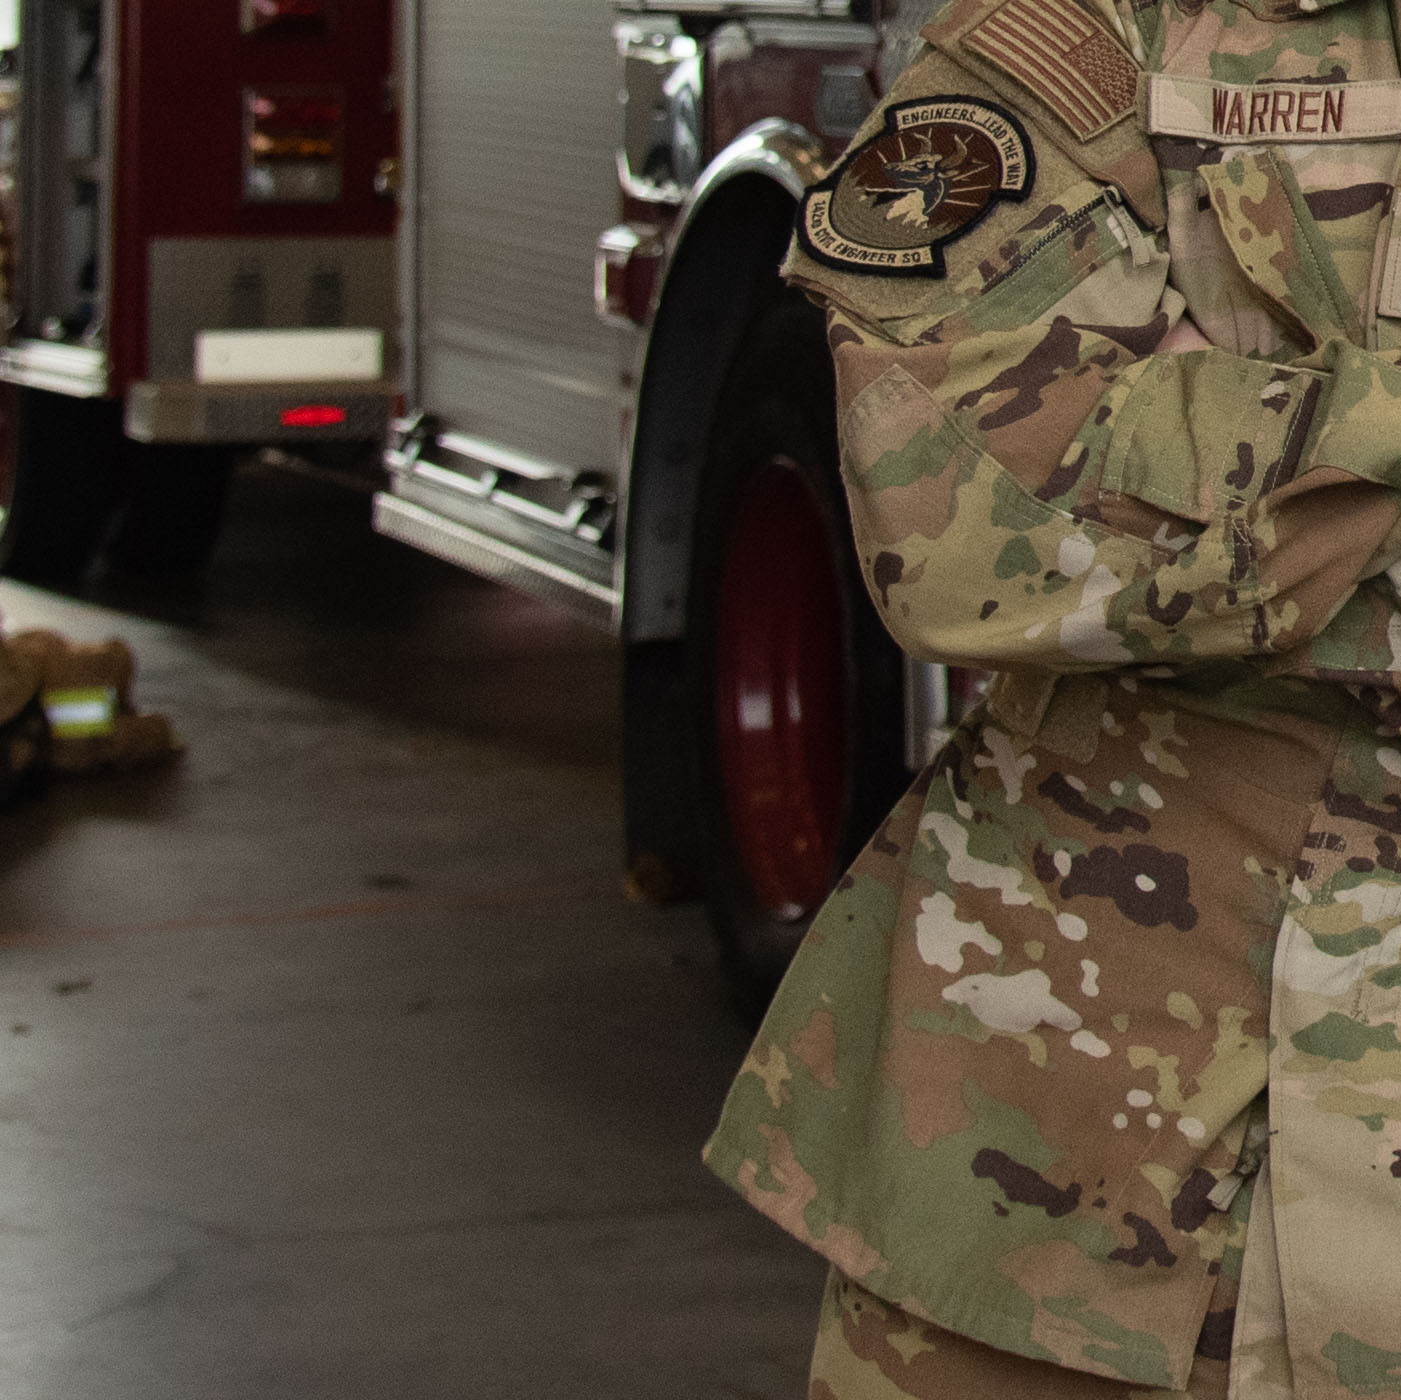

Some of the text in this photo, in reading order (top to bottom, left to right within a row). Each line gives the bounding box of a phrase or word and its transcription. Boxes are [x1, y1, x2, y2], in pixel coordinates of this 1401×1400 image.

[1211, 87, 1346, 136] WARREN
[1000, 137, 1020, 162] THE
[1005, 162, 1021, 188] WAY
[832, 242, 898, 264] ENGINEER
[901, 251, 922, 264] SQ
